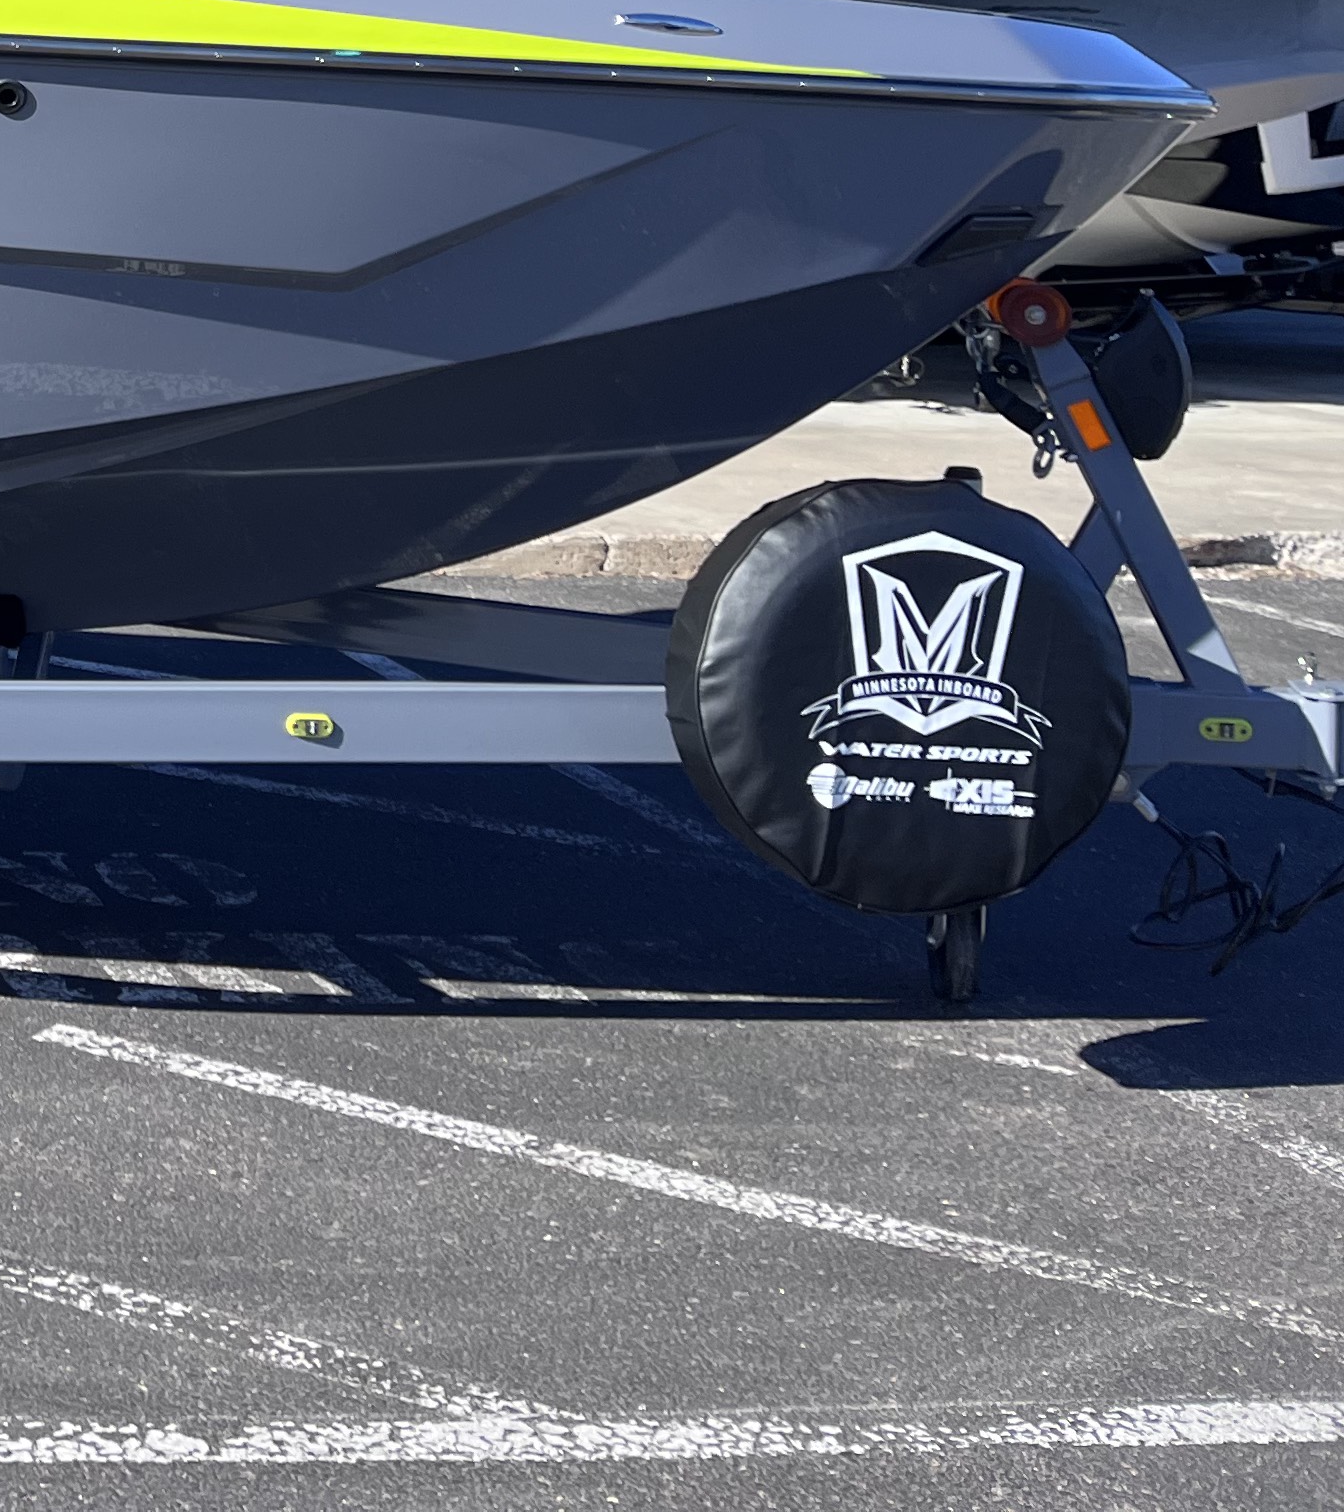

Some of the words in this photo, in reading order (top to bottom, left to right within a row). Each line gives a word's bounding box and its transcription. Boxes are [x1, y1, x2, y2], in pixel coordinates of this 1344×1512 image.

[852, 678, 936, 698] MINNESOTA
[938, 679, 1003, 704] INBOARD
[819, 740, 922, 761] WATER
[925, 745, 1034, 766] SPORTS
